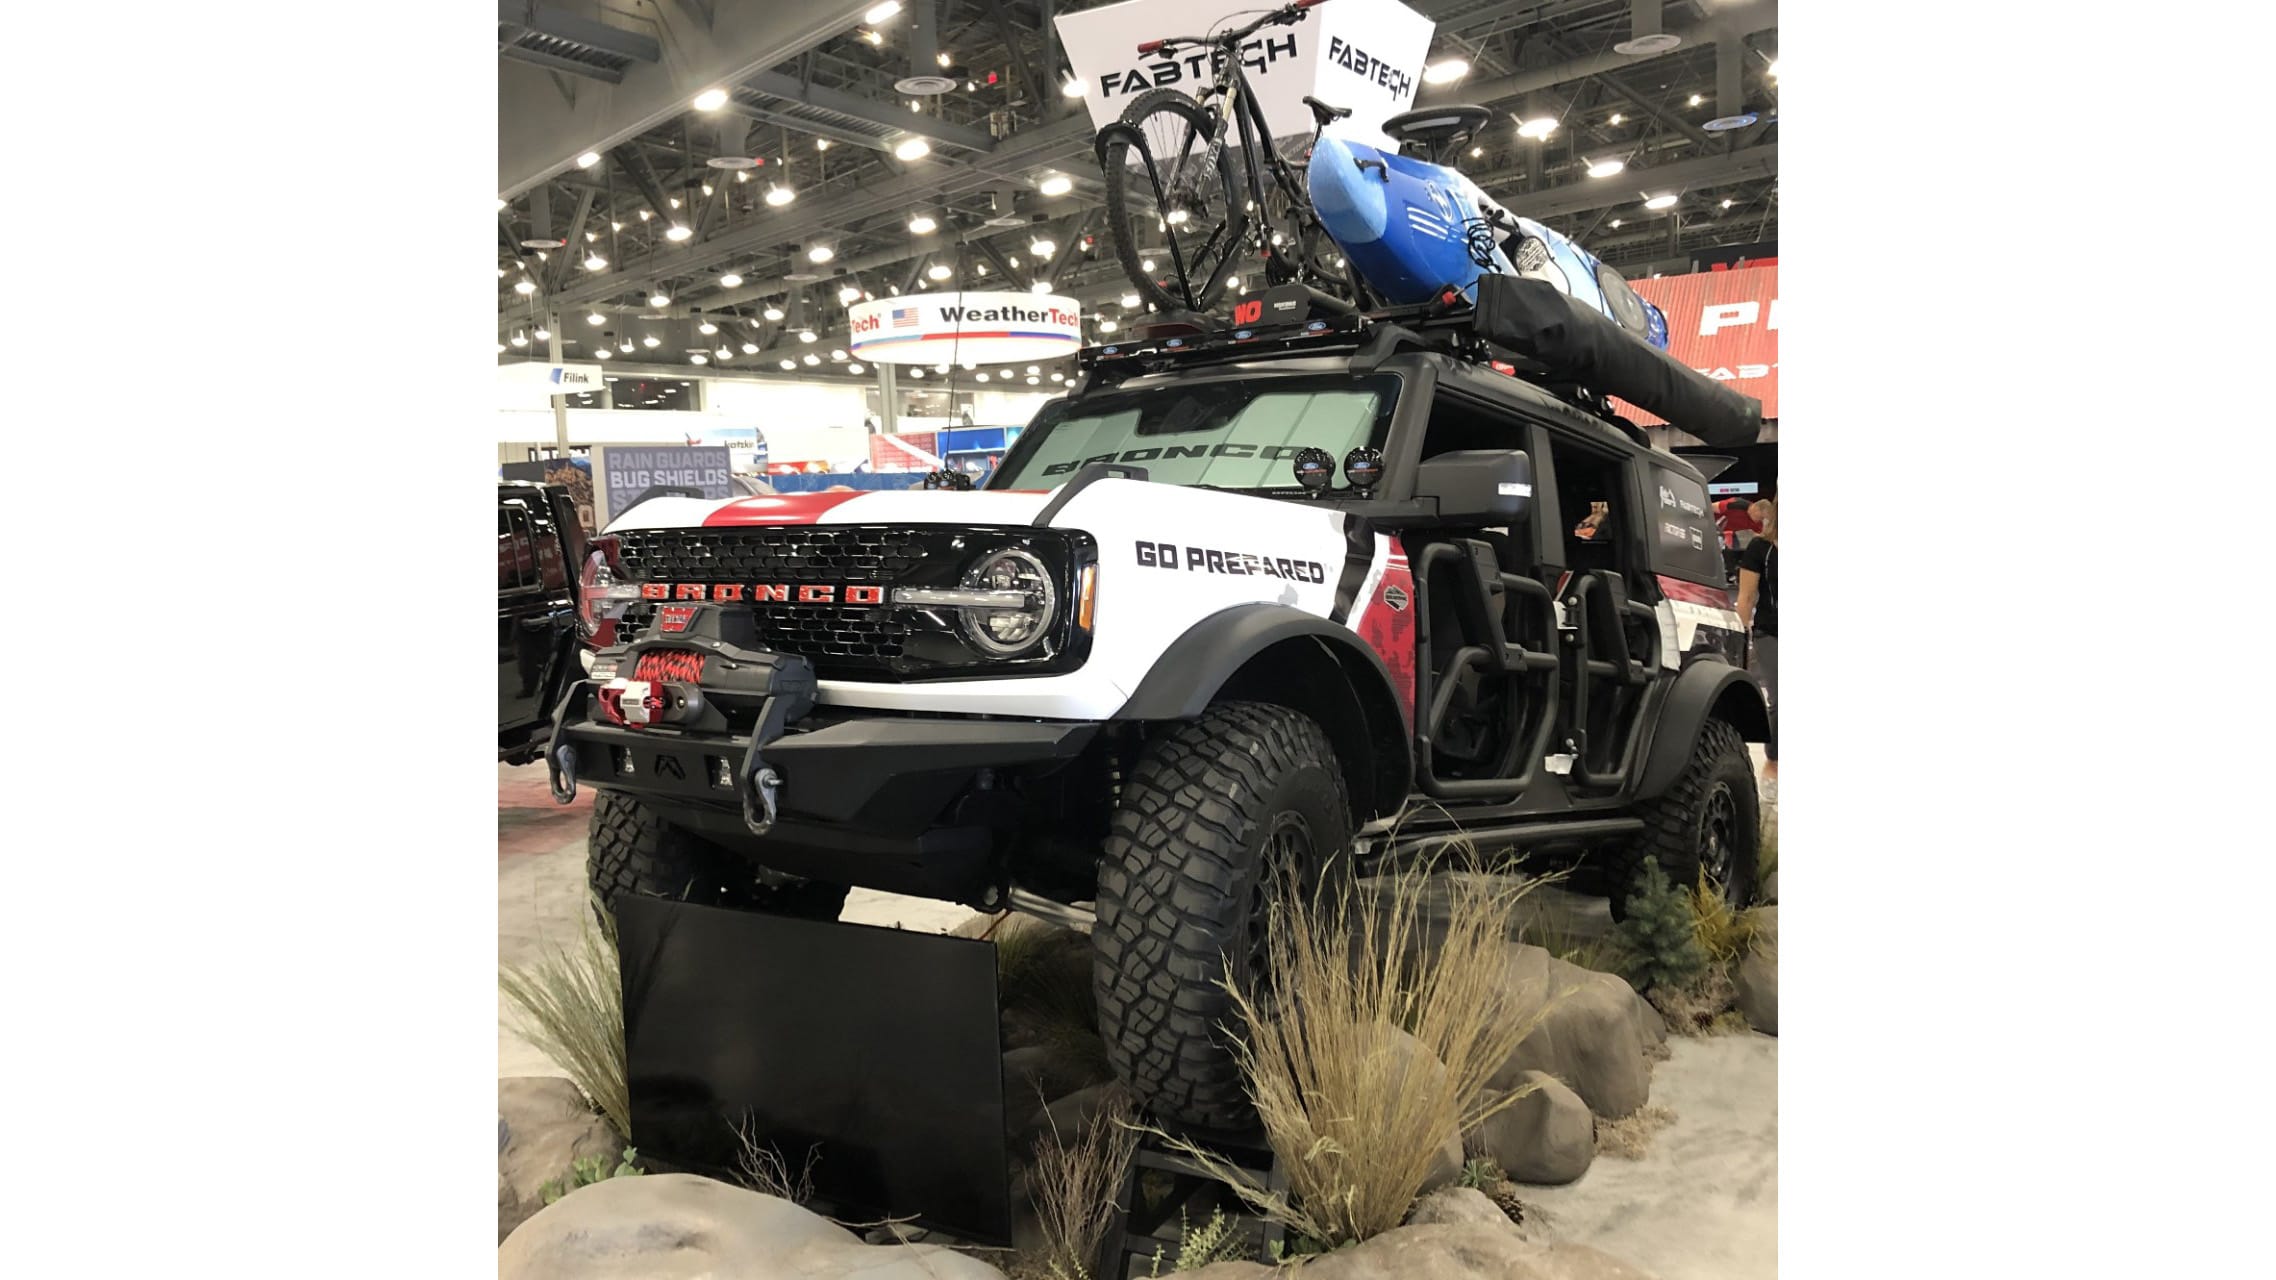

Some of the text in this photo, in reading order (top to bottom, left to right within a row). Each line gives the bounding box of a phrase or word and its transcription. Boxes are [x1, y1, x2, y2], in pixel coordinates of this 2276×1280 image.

[1101, 33, 1298, 97] FABTECH
[1329, 35, 1411, 102] FABTECH
[940, 306, 1079, 327] WeatherTech
[1699, 301, 1778, 336] P
[563, 372, 589, 385] Filink
[609, 451, 727, 469] RAIN GUARDS
[610, 469, 729, 488] BUG SHIELDS
[1135, 540, 1325, 584] GO PREPARED
[641, 583, 885, 605] BRONCO
